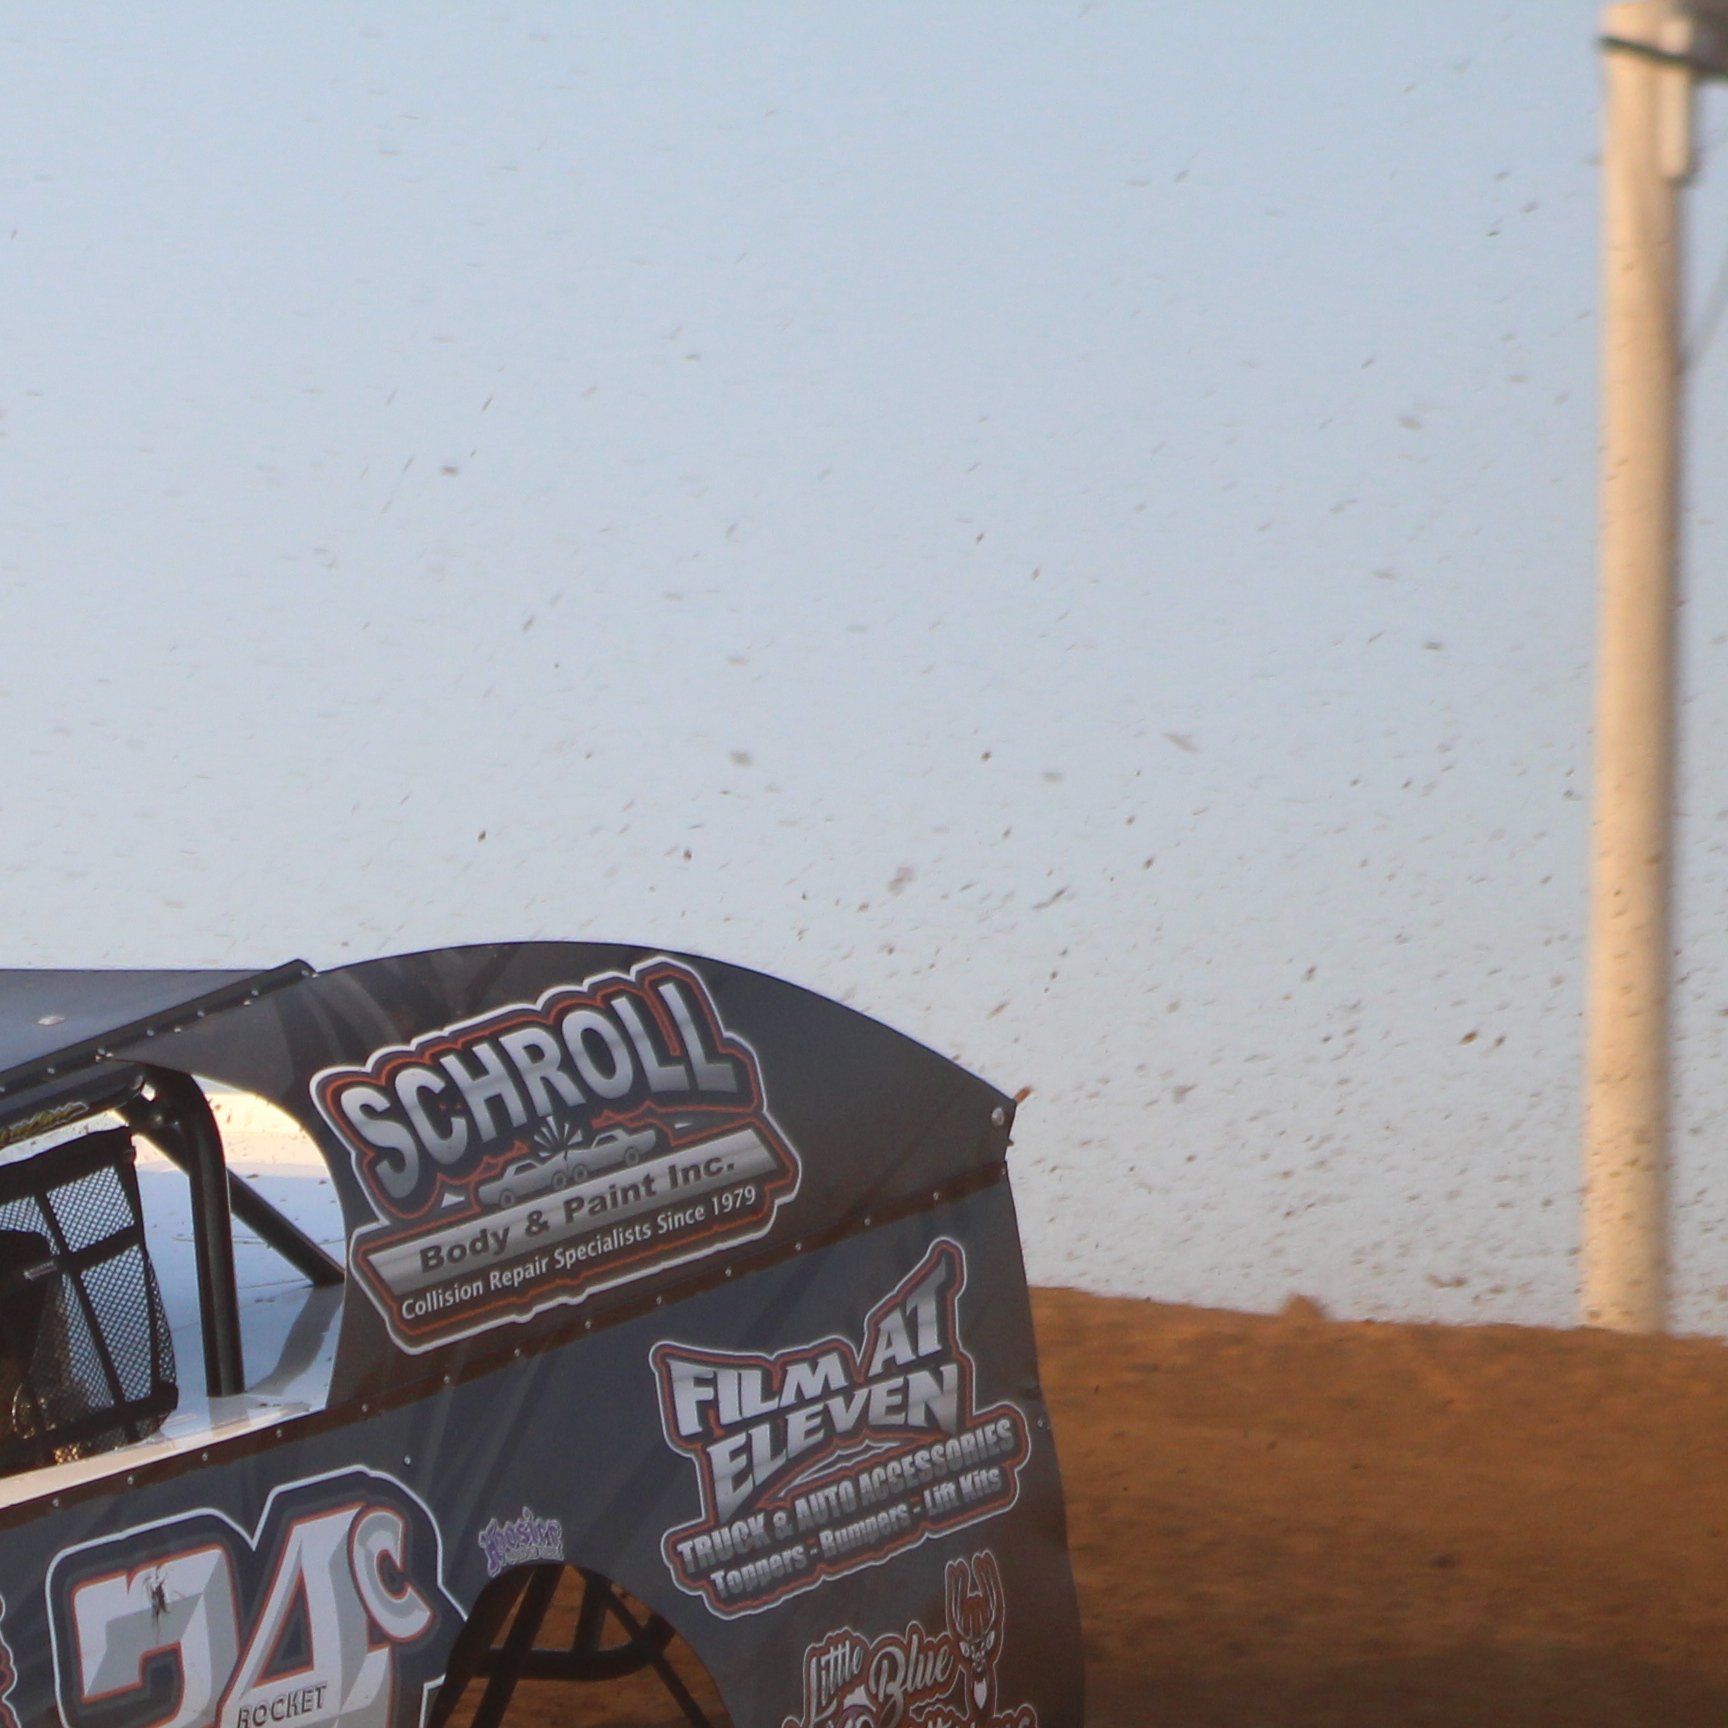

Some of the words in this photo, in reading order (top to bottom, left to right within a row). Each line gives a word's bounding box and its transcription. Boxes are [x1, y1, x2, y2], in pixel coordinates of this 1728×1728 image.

[341, 982, 738, 1199] SCHROLL
[401, 1280, 484, 1320] Collision
[489, 1257, 550, 1295] Repair
[553, 1223, 653, 1270] Specialists
[657, 1203, 706, 1234] Since
[710, 1184, 758, 1217] 1979
[419, 1226, 511, 1273] Body
[525, 1209, 551, 1237] &
[563, 1175, 657, 1224] Paint
[666, 1150, 737, 1190] Inc.
[668, 1351, 849, 1438] FILM
[867, 1261, 952, 1377] AT
[676, 1511, 772, 1575] TRUCK
[772, 1509, 795, 1540] &
[795, 1480, 858, 1533] AUTO
[858, 1418, 1016, 1508] ACCESSORIES
[705, 1362, 960, 1524] ELEVEN
[709, 1545, 808, 1600] Toppers
[818, 1503, 912, 1559] Bumpers
[958, 1467, 1003, 1501] Kits
[806, 1639, 864, 1724] Little
